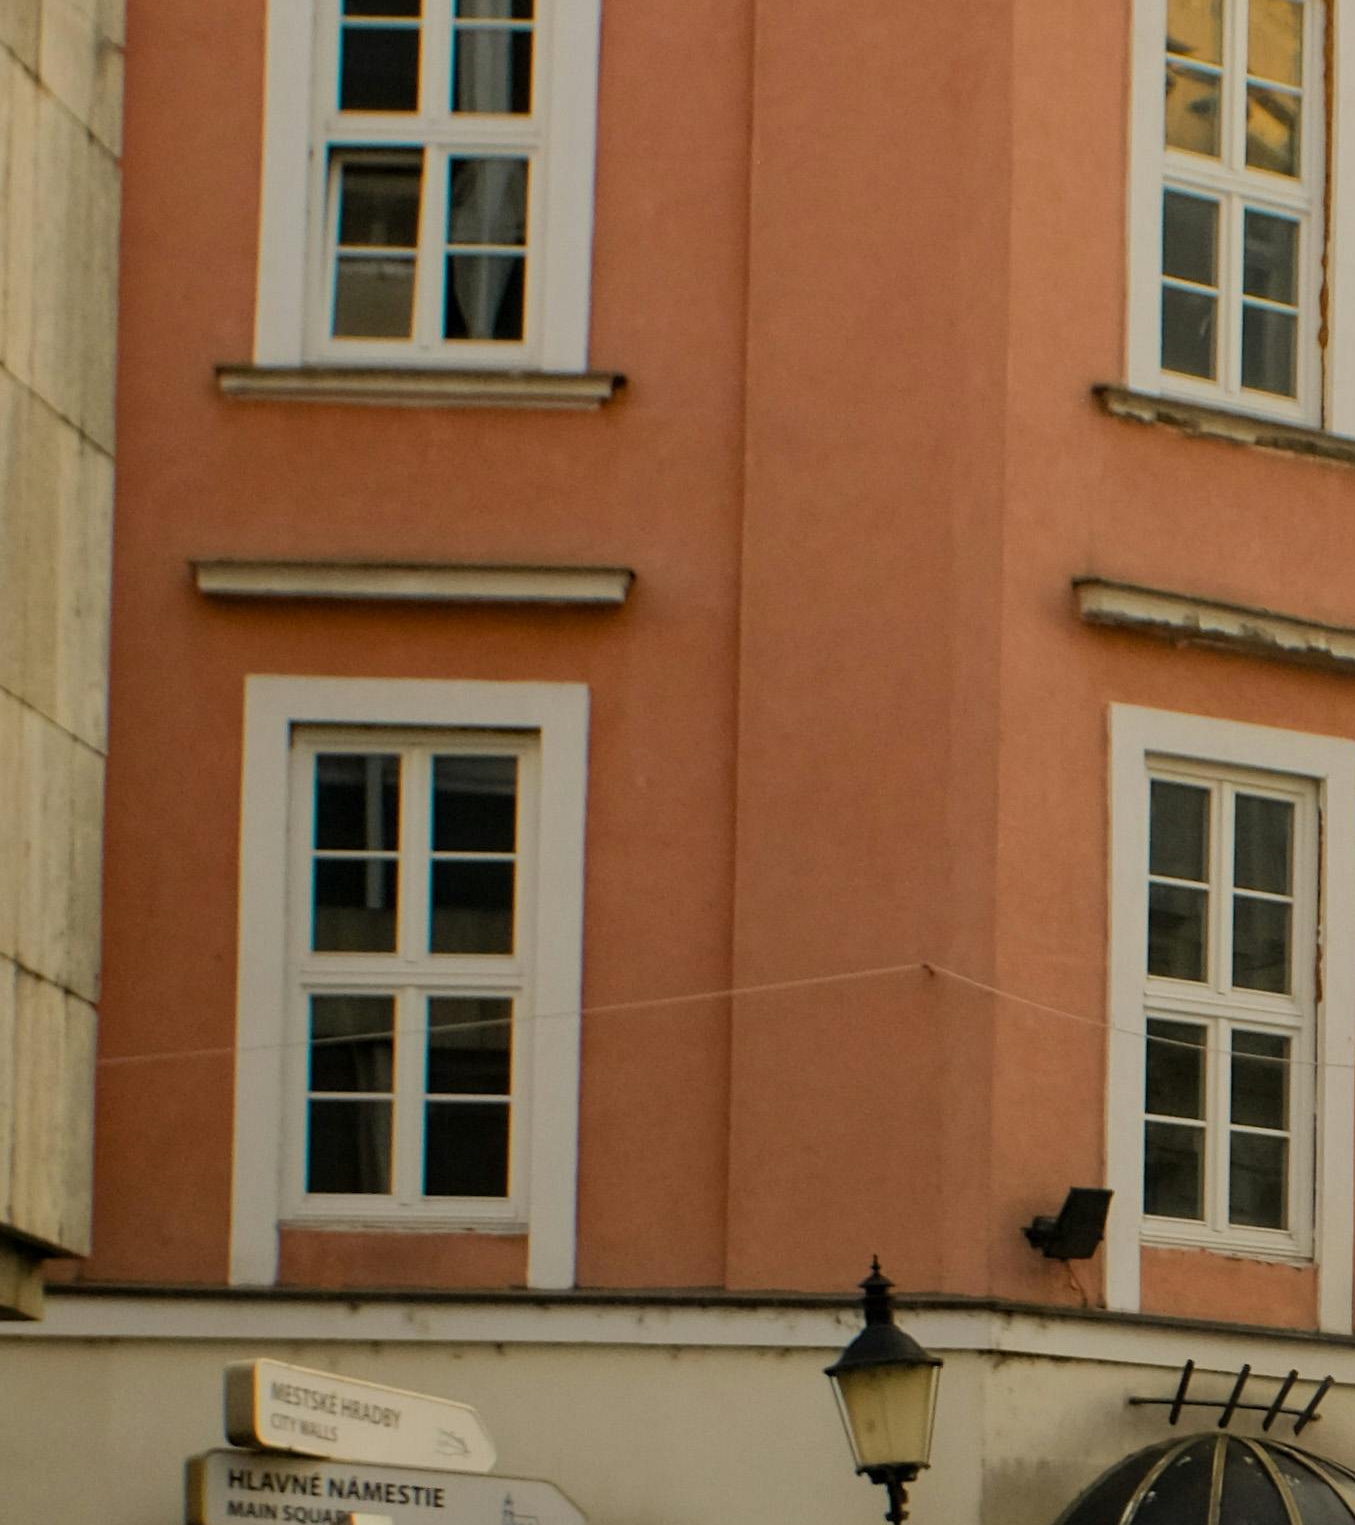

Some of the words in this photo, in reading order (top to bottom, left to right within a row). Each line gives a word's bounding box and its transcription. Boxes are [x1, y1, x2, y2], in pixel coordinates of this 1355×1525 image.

[271, 1381, 338, 1415] MESTSKÉ
[341, 1398, 402, 1430] HRADBY
[271, 1411, 297, 1434] CITY
[300, 1417, 338, 1442] WALLS
[228, 1466, 322, 1497] HLAVNÉ
[327, 1475, 445, 1508] NÁMESTIE
[227, 1500, 278, 1520] MAIN
[283, 1504, 352, 1525] SQUAR
